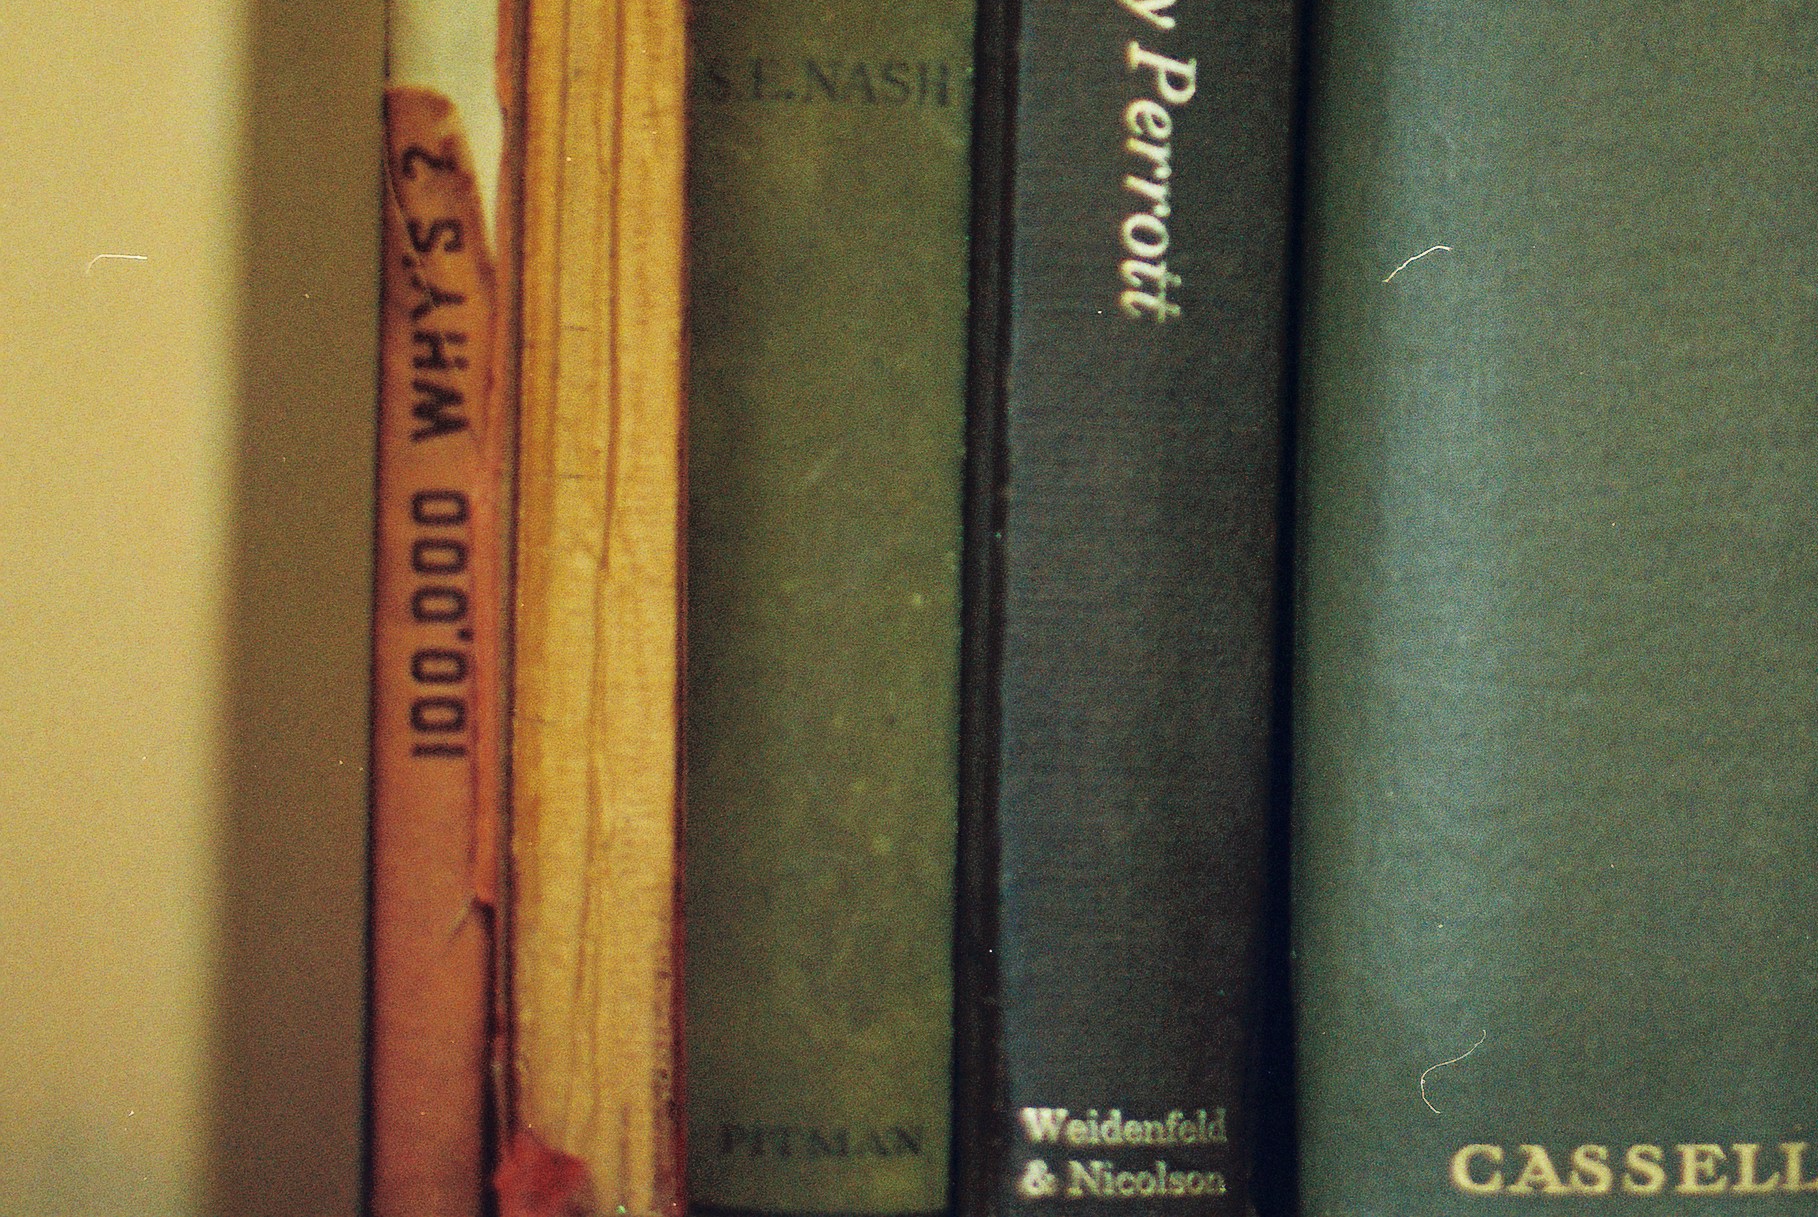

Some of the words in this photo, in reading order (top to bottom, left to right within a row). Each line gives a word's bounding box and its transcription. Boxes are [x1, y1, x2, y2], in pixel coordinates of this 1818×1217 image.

[1120, 41, 1198, 324] Perrott
[720, 1122, 925, 1158] PITMAN
[1020, 1107, 1228, 1146] Weidenfeld
[1020, 1160, 1056, 1196] &
[1067, 1160, 1228, 1197] Nicolson
